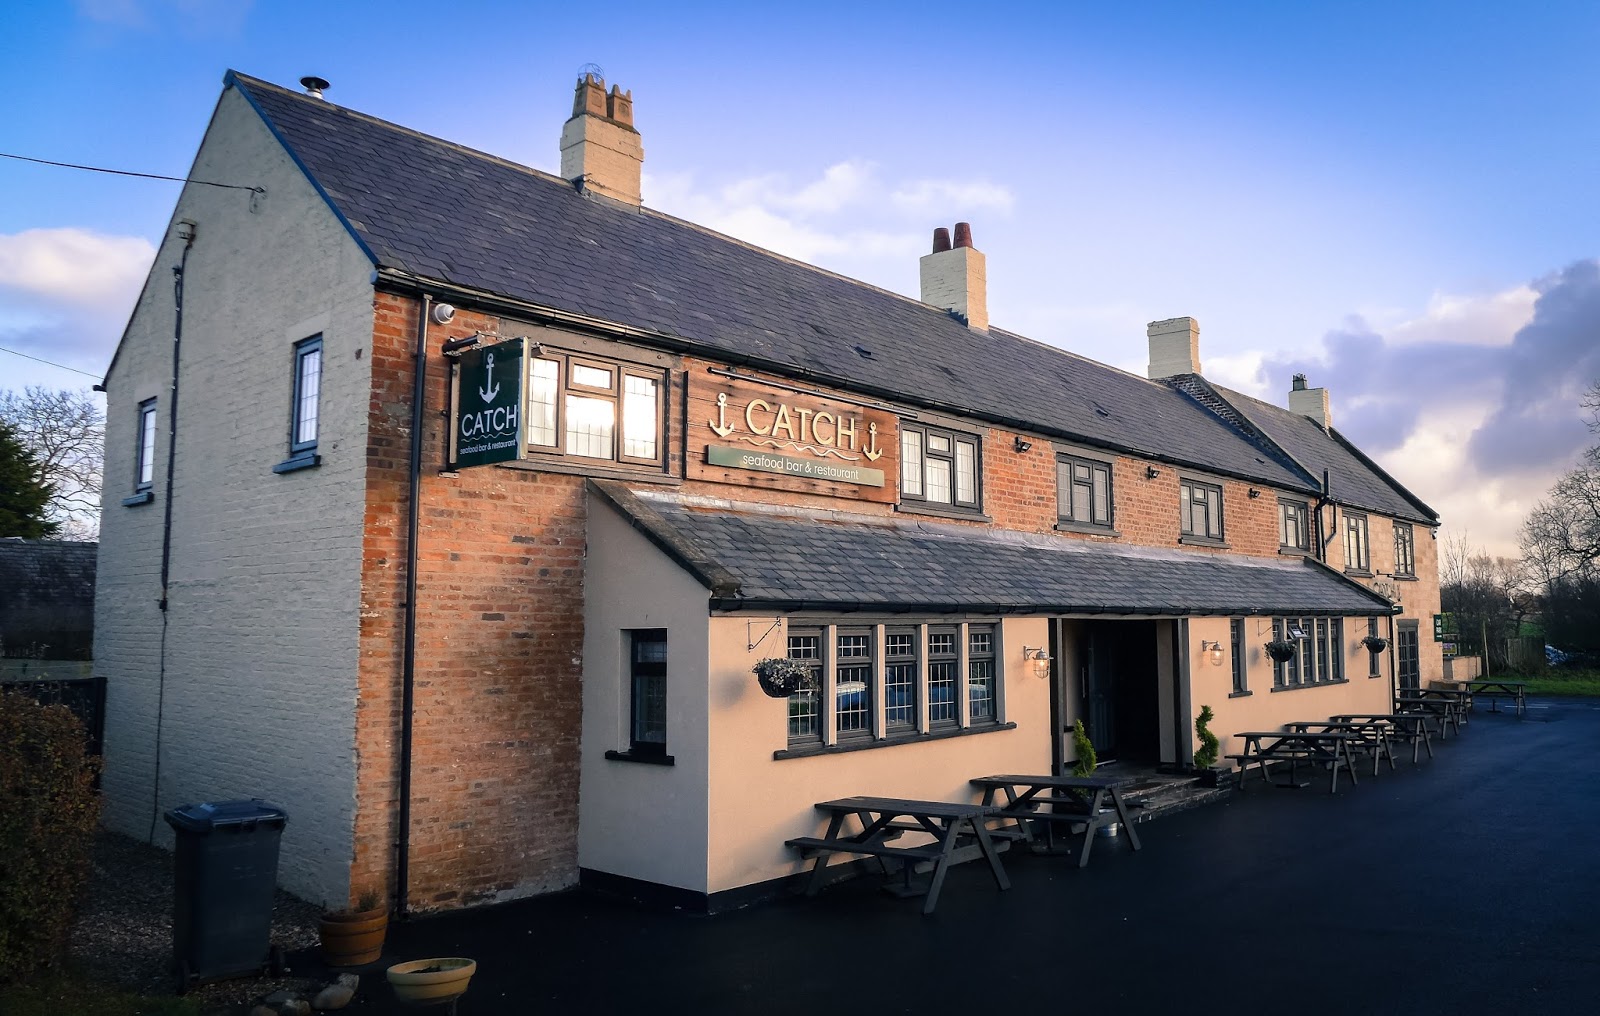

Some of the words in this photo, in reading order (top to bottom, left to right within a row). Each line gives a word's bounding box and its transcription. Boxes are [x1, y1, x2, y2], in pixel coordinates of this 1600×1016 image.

[461, 404, 517, 436] CATCH
[746, 399, 855, 449] CATCH
[460, 444, 479, 454] seafood
[479, 443, 488, 452] bar
[492, 439, 516, 449] restaurant
[742, 454, 784, 469] seafood
[786, 458, 803, 472] bar
[804, 461, 812, 473] &
[814, 465, 860, 480] restaurant
